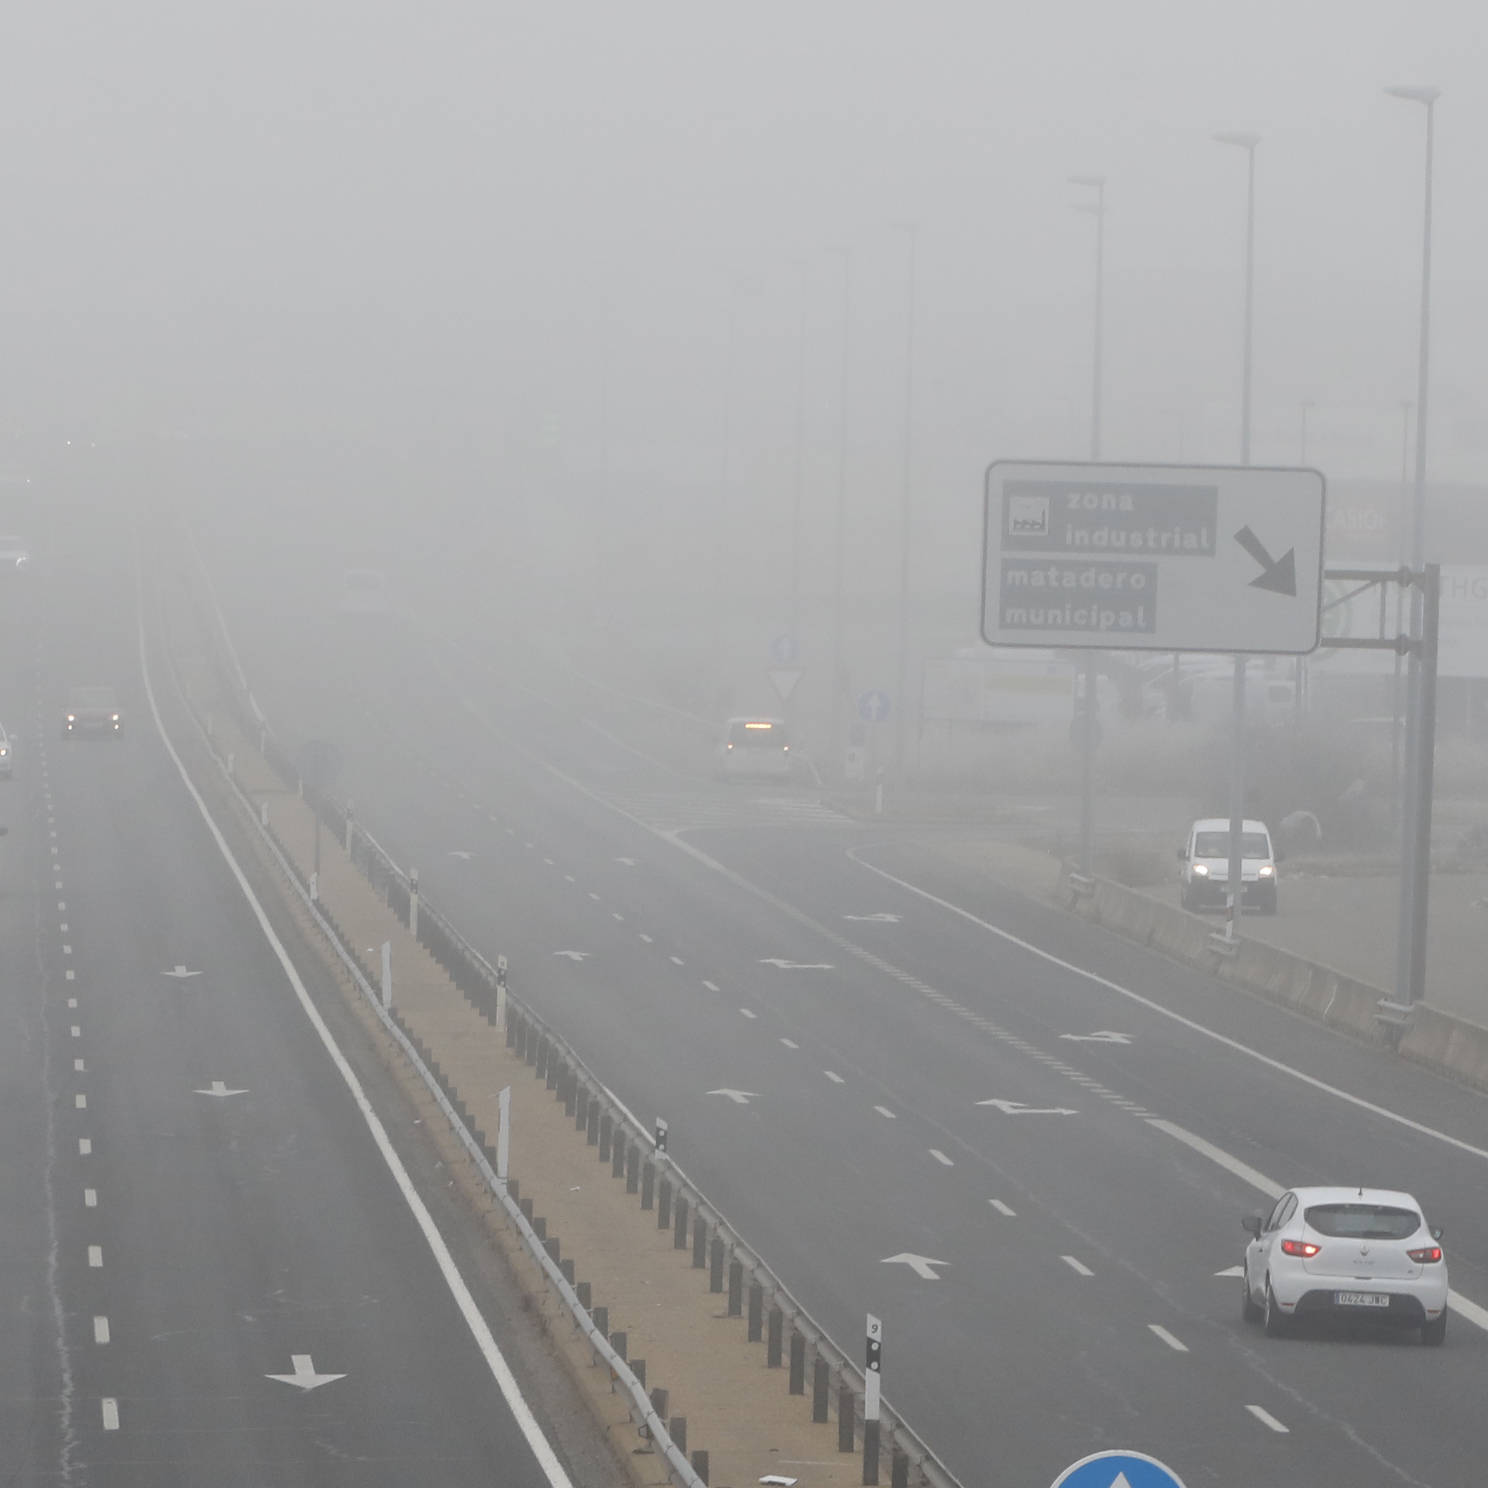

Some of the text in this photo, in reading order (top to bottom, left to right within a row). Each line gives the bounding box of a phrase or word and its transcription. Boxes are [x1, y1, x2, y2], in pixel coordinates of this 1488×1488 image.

[1066, 492, 1135, 512] zona
[1065, 521, 1211, 550] industrial
[1007, 567, 1146, 590] matadero
[1005, 603, 1150, 630] municipal
